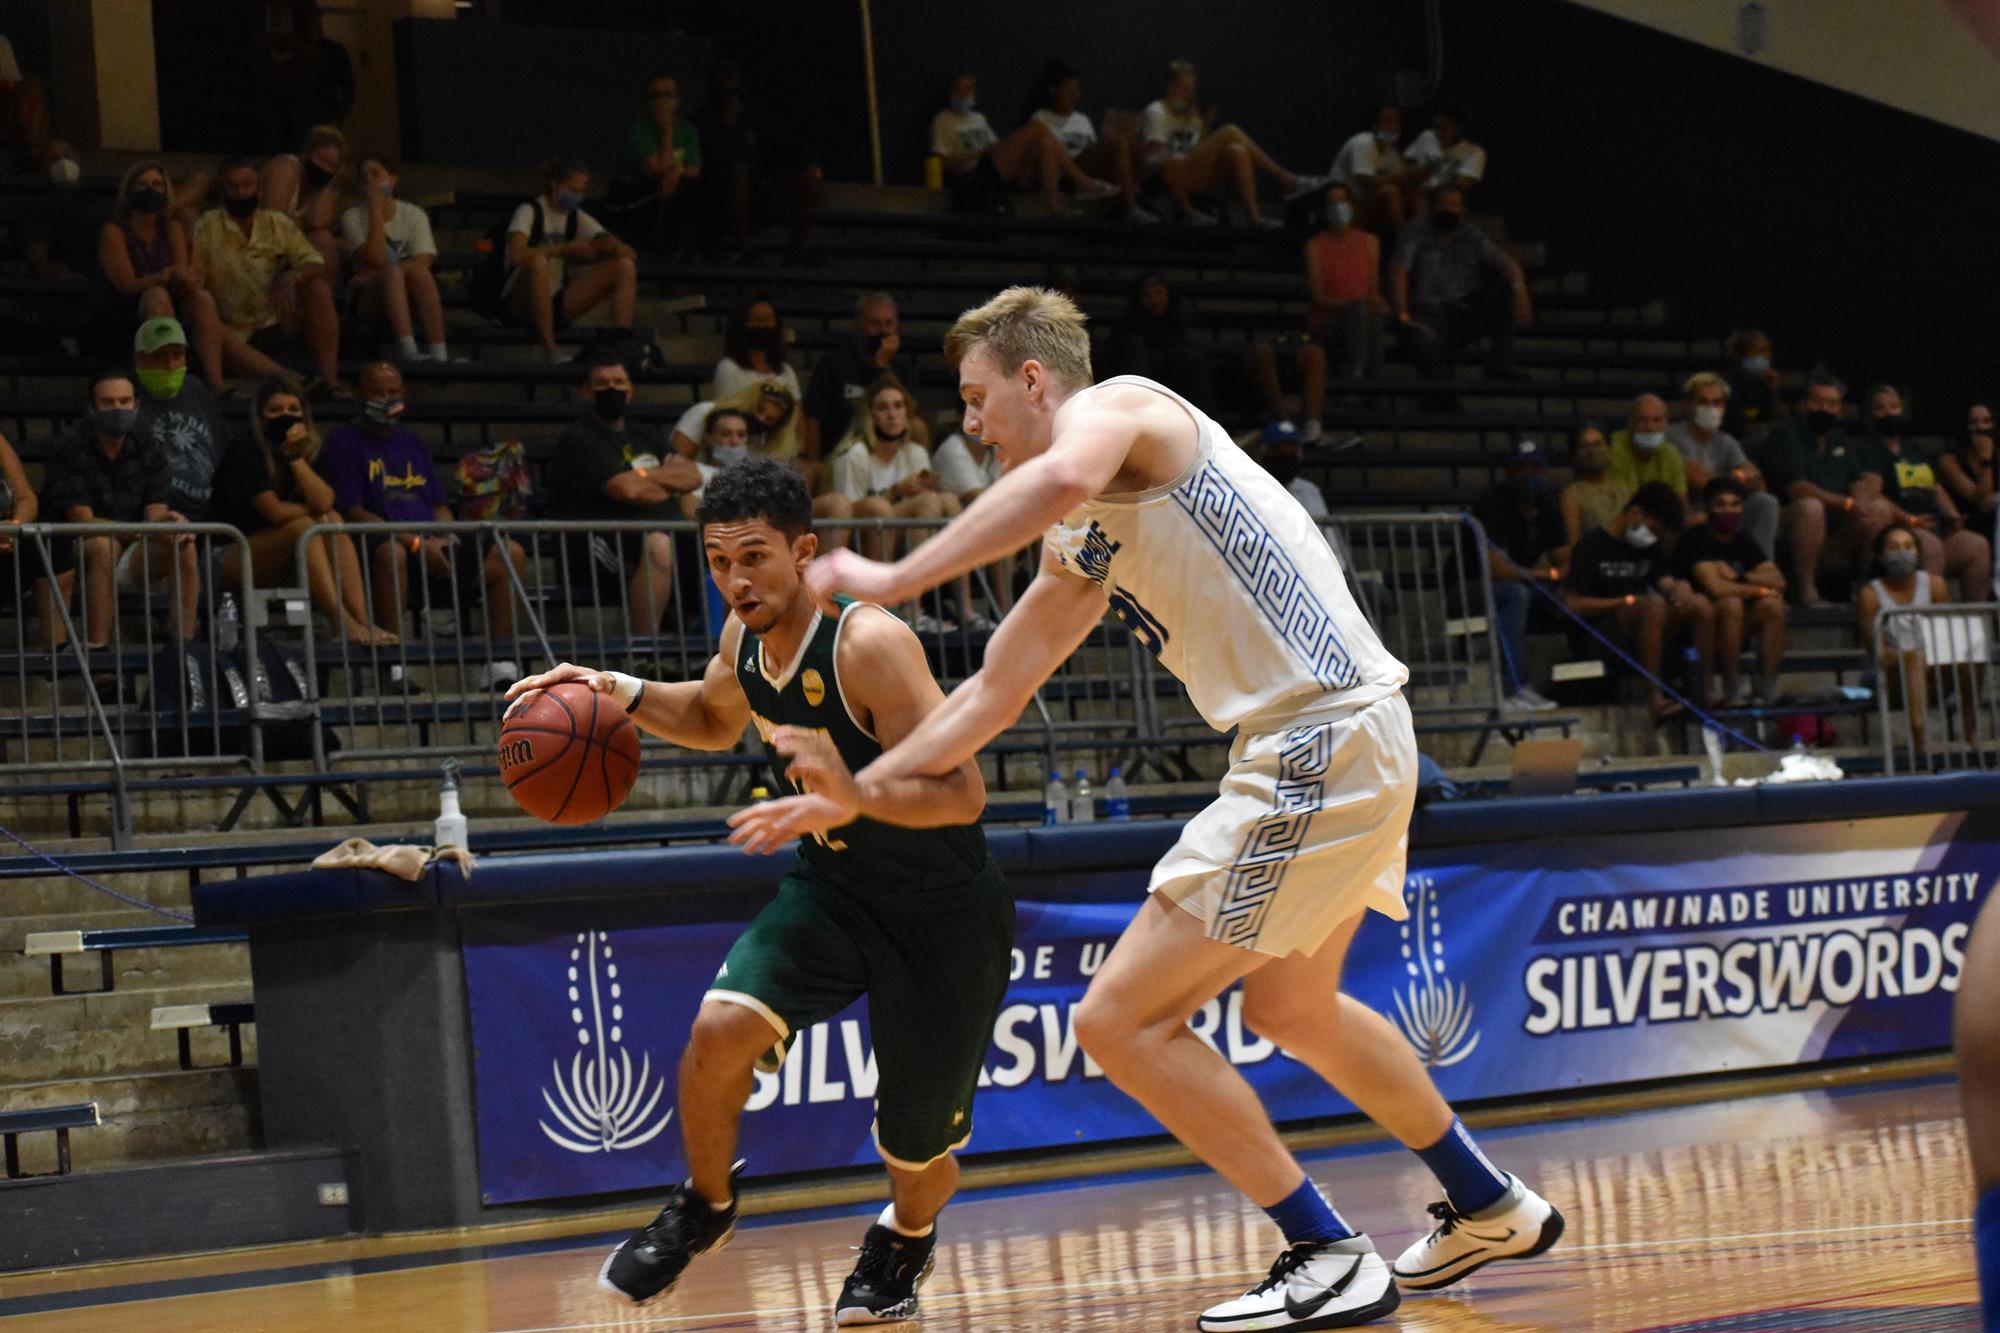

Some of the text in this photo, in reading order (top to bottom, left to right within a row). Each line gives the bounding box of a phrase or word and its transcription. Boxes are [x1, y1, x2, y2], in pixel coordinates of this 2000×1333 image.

[1557, 872, 1980, 936] CHAMINADE UNIVERSITY
[1523, 921, 1969, 1036] SILVERSWORDS
